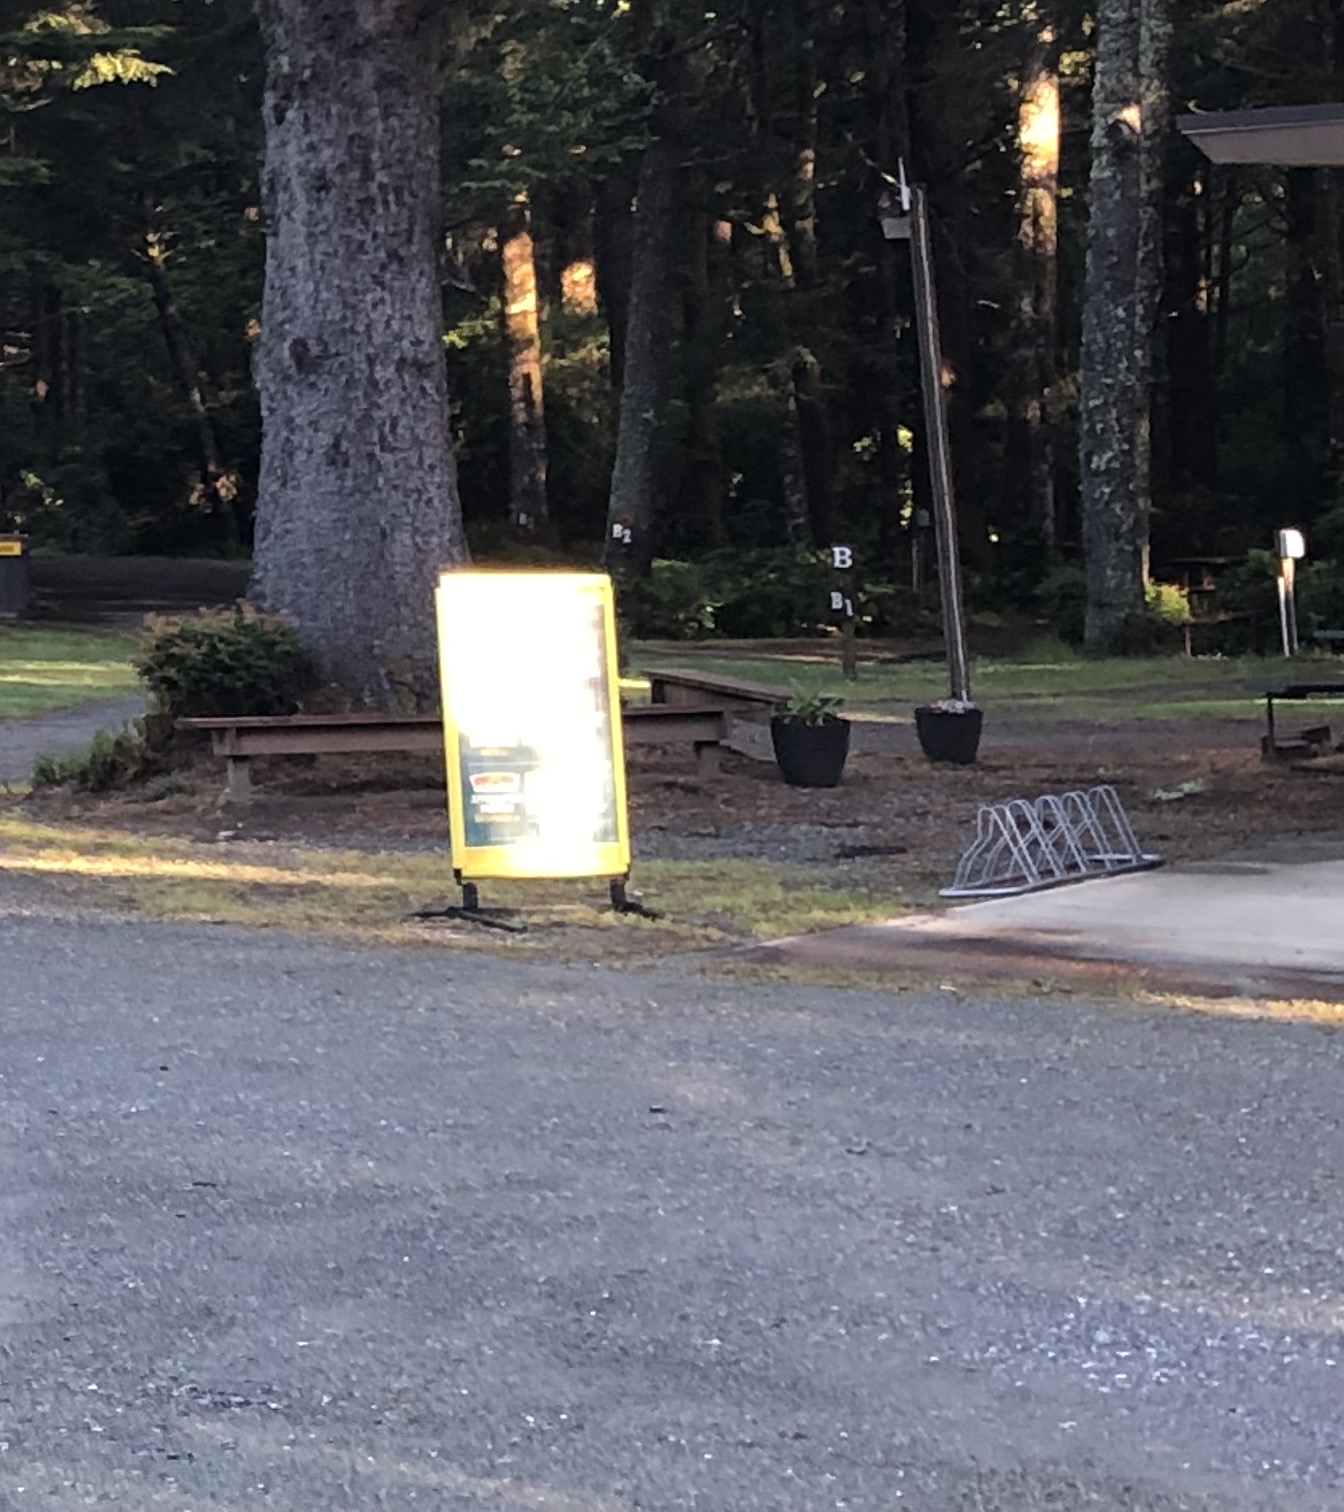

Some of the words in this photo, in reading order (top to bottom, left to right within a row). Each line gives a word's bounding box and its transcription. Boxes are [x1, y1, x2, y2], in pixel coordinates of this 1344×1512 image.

[611, 523, 632, 544] B2
[831, 546, 853, 569] B
[830, 591, 854, 616] B1
